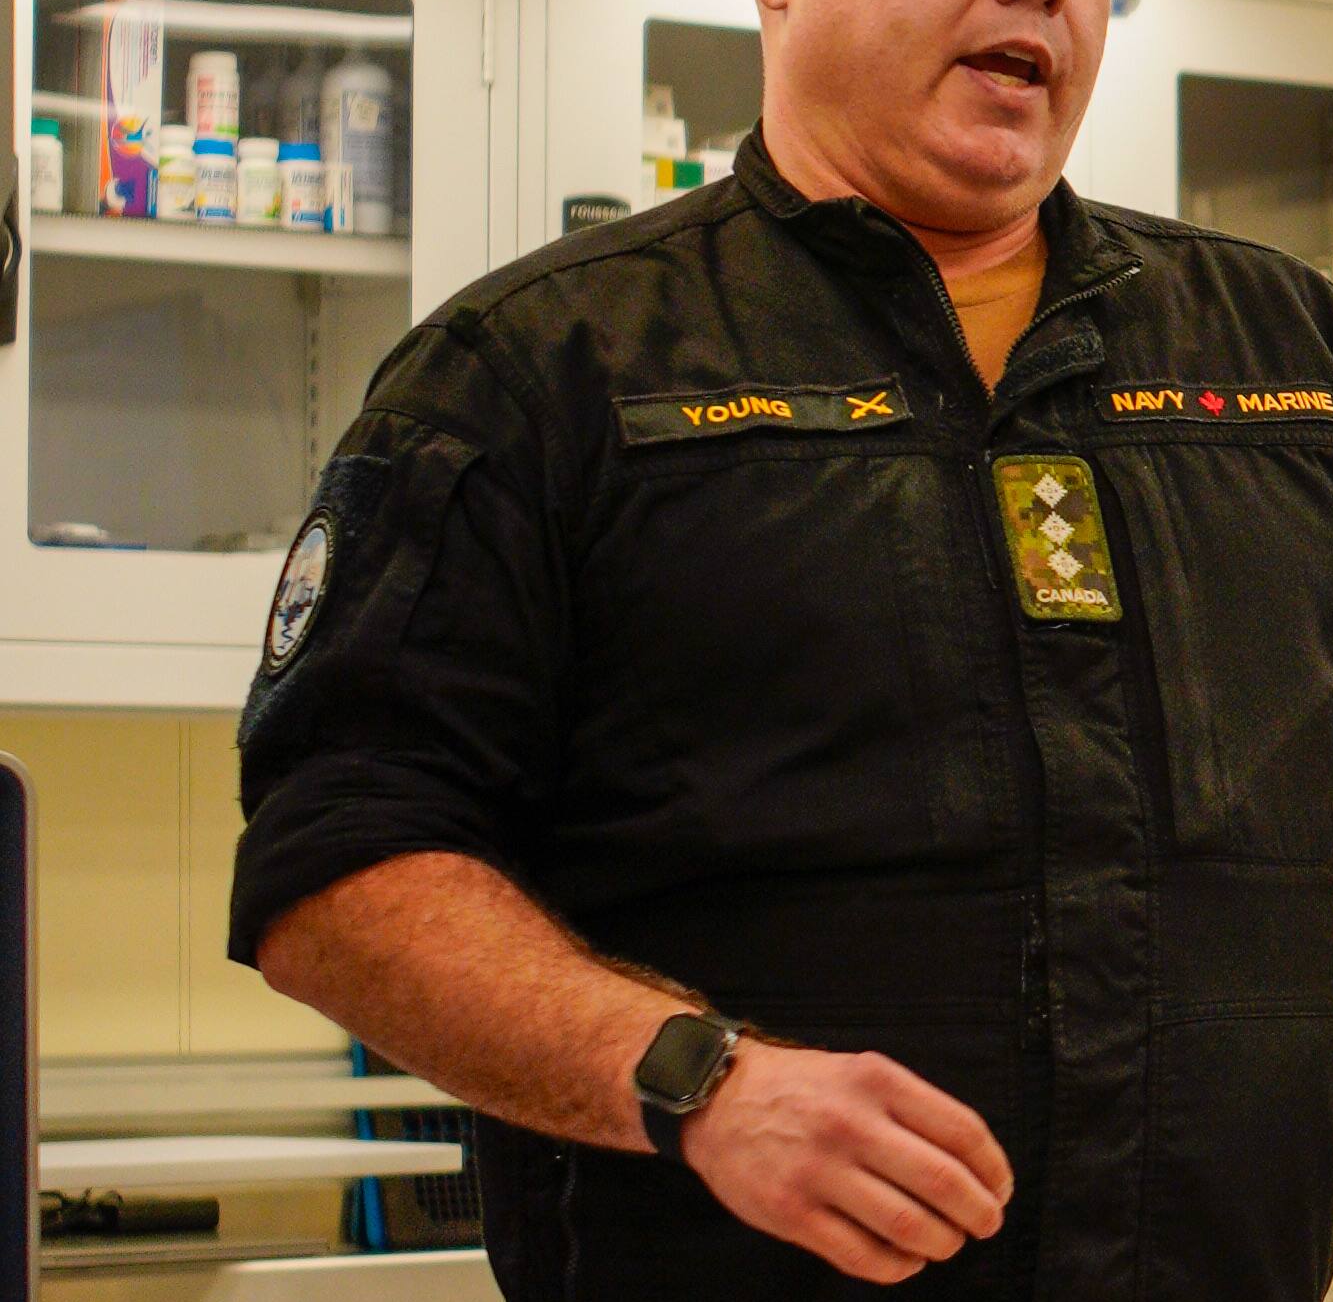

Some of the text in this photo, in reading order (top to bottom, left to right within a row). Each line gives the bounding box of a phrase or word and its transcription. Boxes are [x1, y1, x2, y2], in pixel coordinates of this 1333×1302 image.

[682, 396, 793, 427] YOUNG
[1111, 389, 1184, 412] NAVY
[1036, 588, 1109, 606] CANADA
